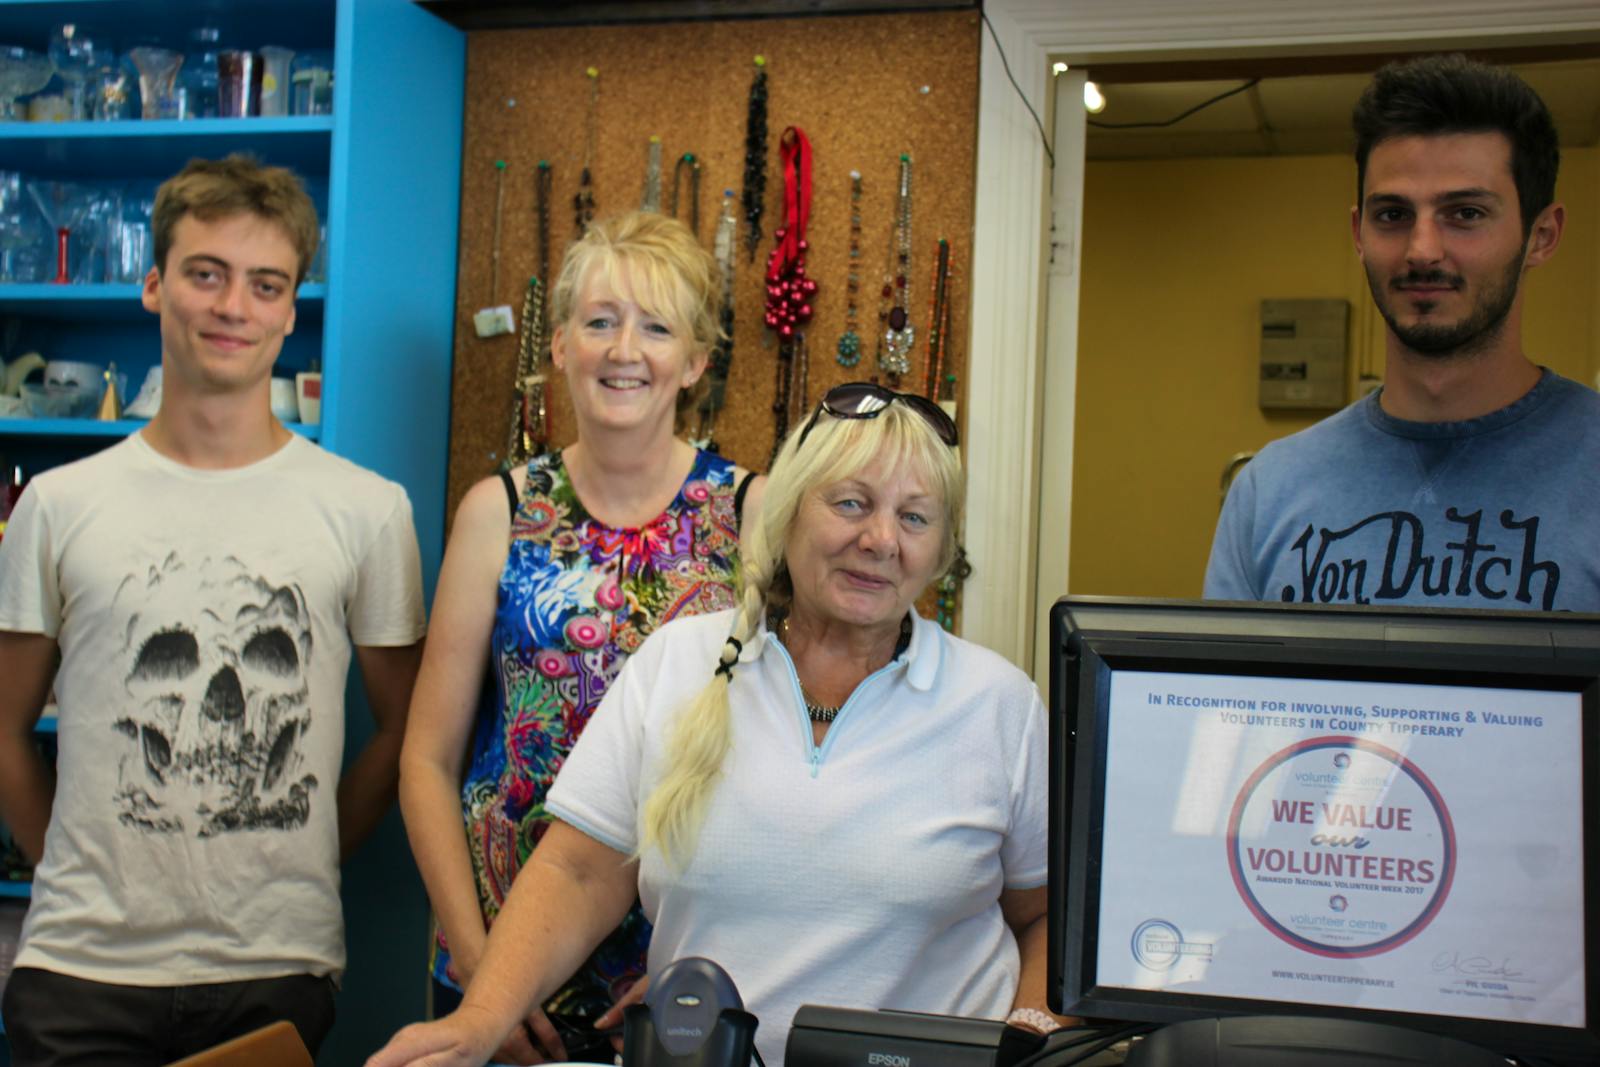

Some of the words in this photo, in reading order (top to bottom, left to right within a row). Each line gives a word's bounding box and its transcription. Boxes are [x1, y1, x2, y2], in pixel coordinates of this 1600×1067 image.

[1282, 524, 1369, 604] Von
[1374, 507, 1560, 610] Dutch
[1167, 694, 1256, 710] RECOGNITION
[1261, 701, 1287, 712] FOR
[1291, 703, 1367, 718] INVOLVING,
[1371, 705, 1460, 722] SUPPORTING
[1465, 710, 1477, 723] &
[1482, 712, 1543, 727] VALUING
[1220, 712, 1306, 728] VOLUNTEERS
[1310, 719, 1324, 729] IN
[1329, 718, 1385, 734] COUNTY
[1388, 721, 1464, 737] TIPPERARY
[1295, 772, 1346, 785] volunte
[1272, 800, 1315, 824] WE
[1322, 803, 1412, 831] VALUE
[1310, 833, 1370, 849] our
[1247, 847, 1435, 884] VOLUNTEERS
[1256, 875, 1293, 885] AWARDED
[1295, 878, 1332, 888] NATIONAL
[1334, 881, 1379, 891] VOLUNTEER
[1405, 886, 1424, 895] 2017
[1290, 913, 1345, 927] volunteer
[1349, 919, 1387, 930] centre
[868, 1053, 911, 1067] EPSON
